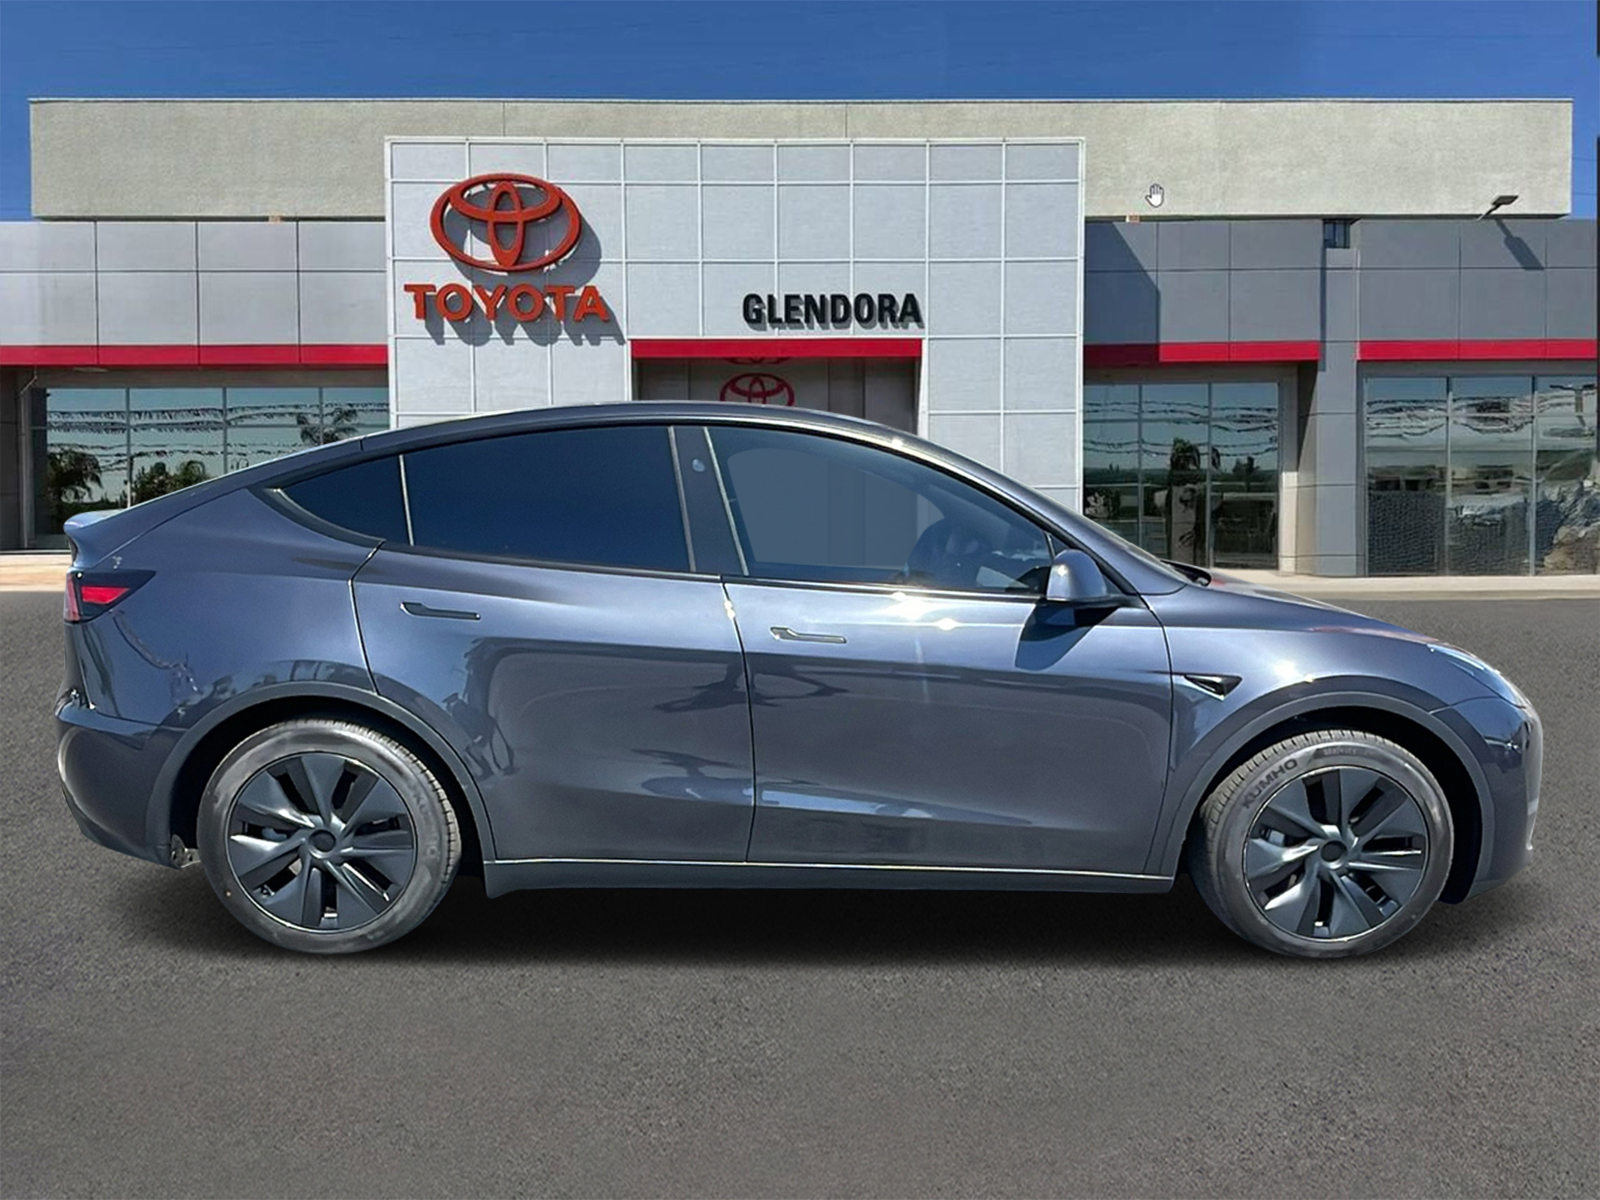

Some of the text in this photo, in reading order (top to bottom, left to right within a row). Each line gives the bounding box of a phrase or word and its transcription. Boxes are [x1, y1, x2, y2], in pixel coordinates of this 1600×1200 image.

[404, 283, 610, 322] TOYOTA
[743, 293, 923, 325] GLENDORA
[1242, 758, 1298, 809] KUMHO
